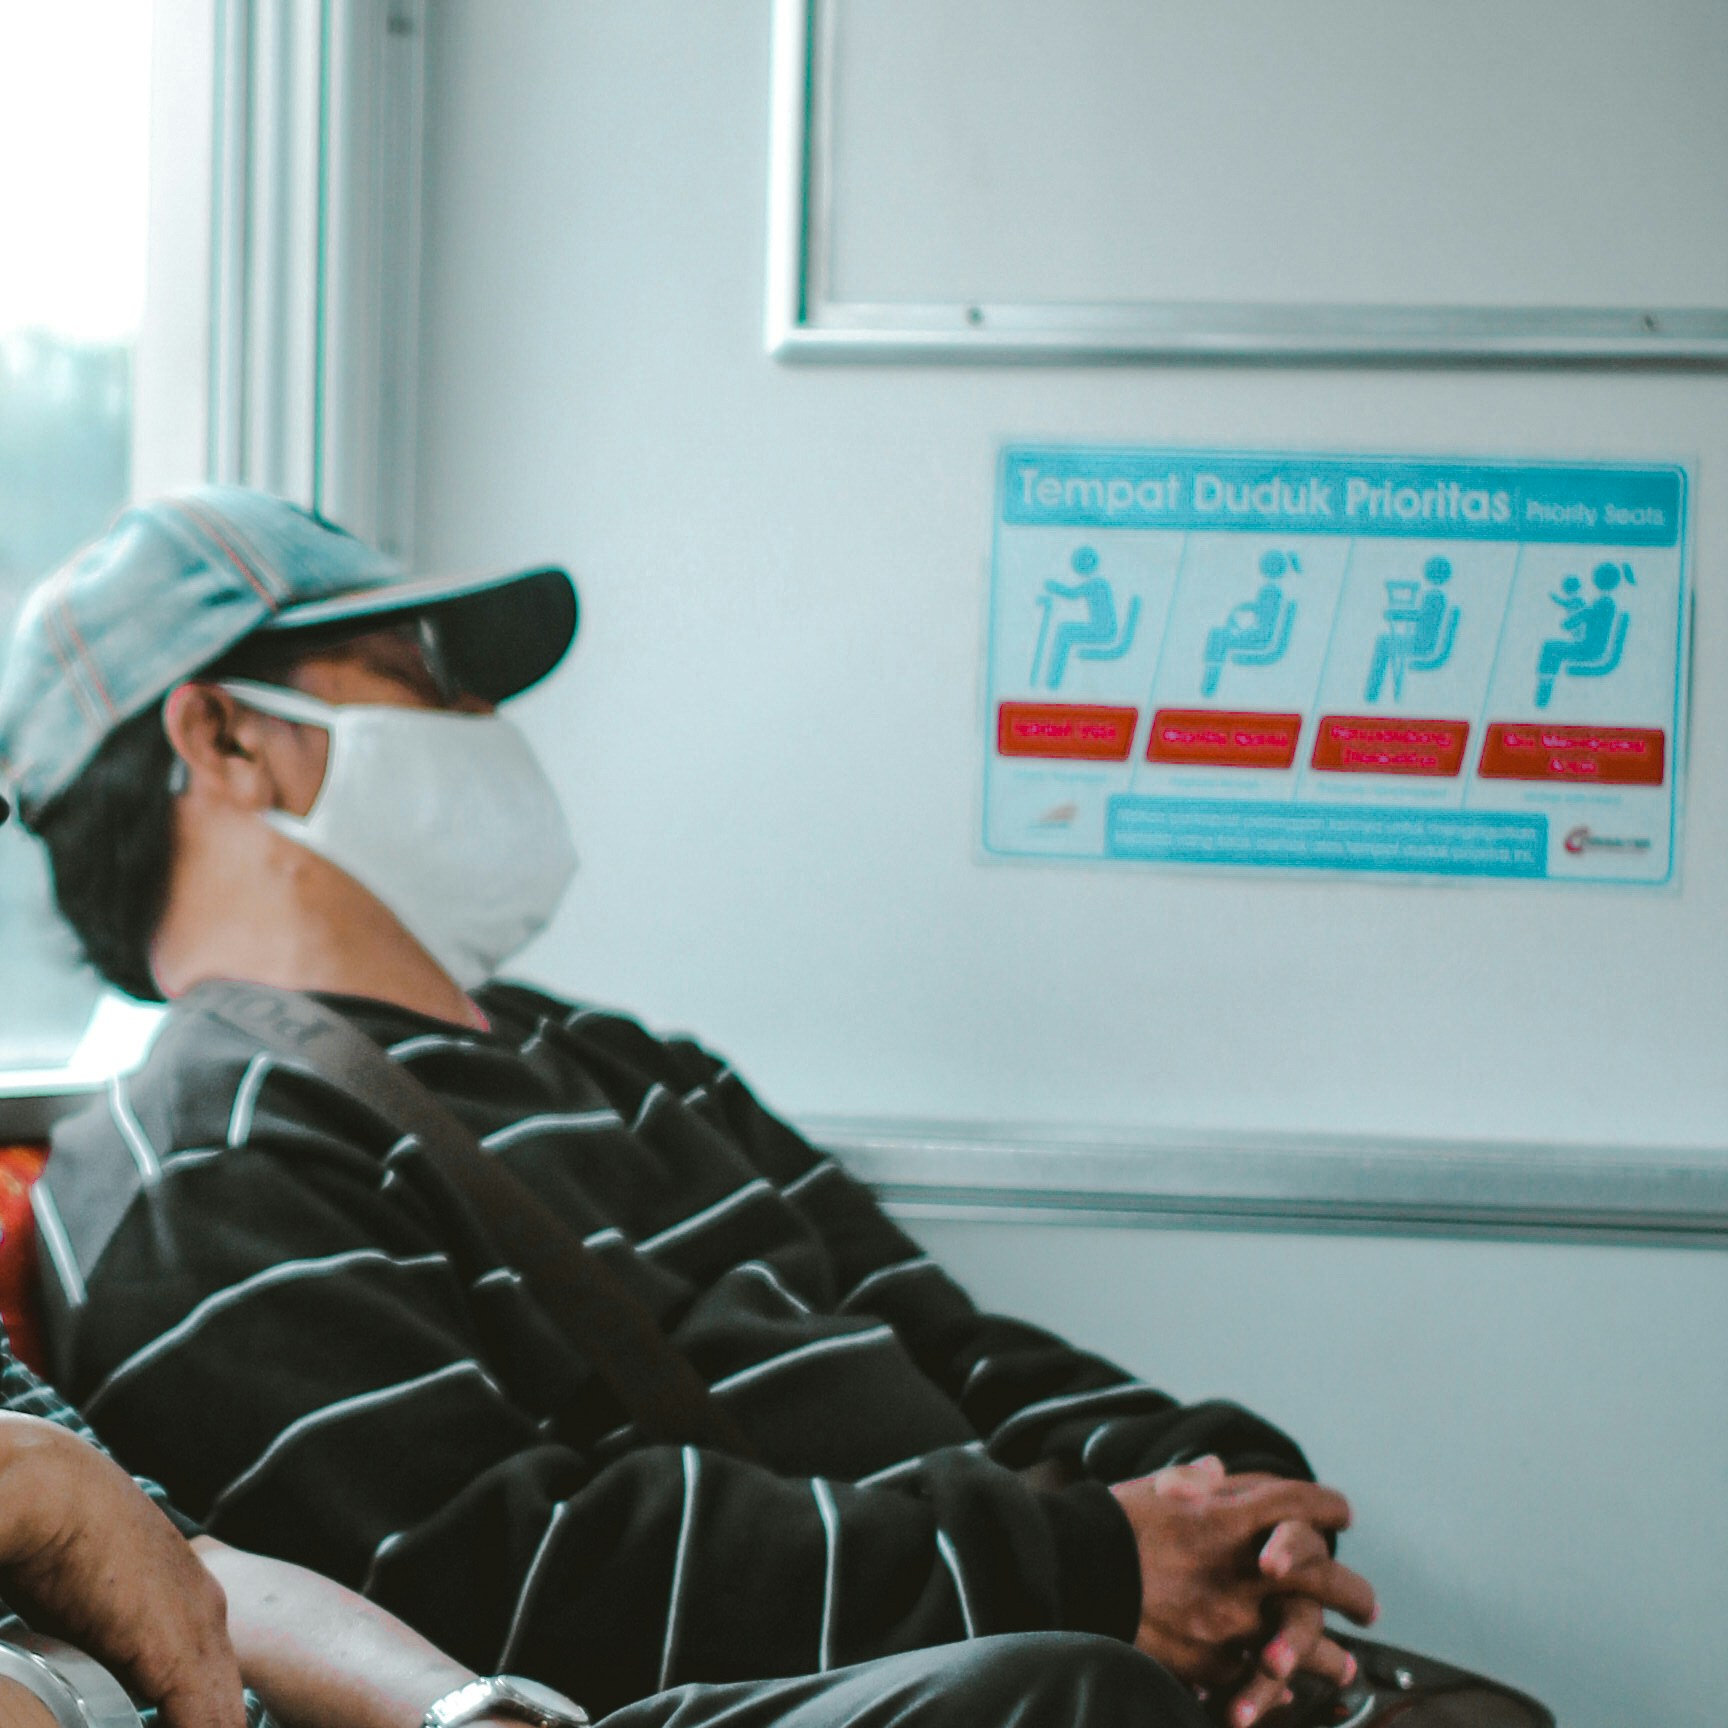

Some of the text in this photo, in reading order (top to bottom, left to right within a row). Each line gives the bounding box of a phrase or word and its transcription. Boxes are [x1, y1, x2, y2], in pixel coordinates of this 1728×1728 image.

[1020, 467, 1181, 516] Tempat
[1194, 473, 1333, 516] Duduk
[1345, 477, 1512, 522] Prioritas
